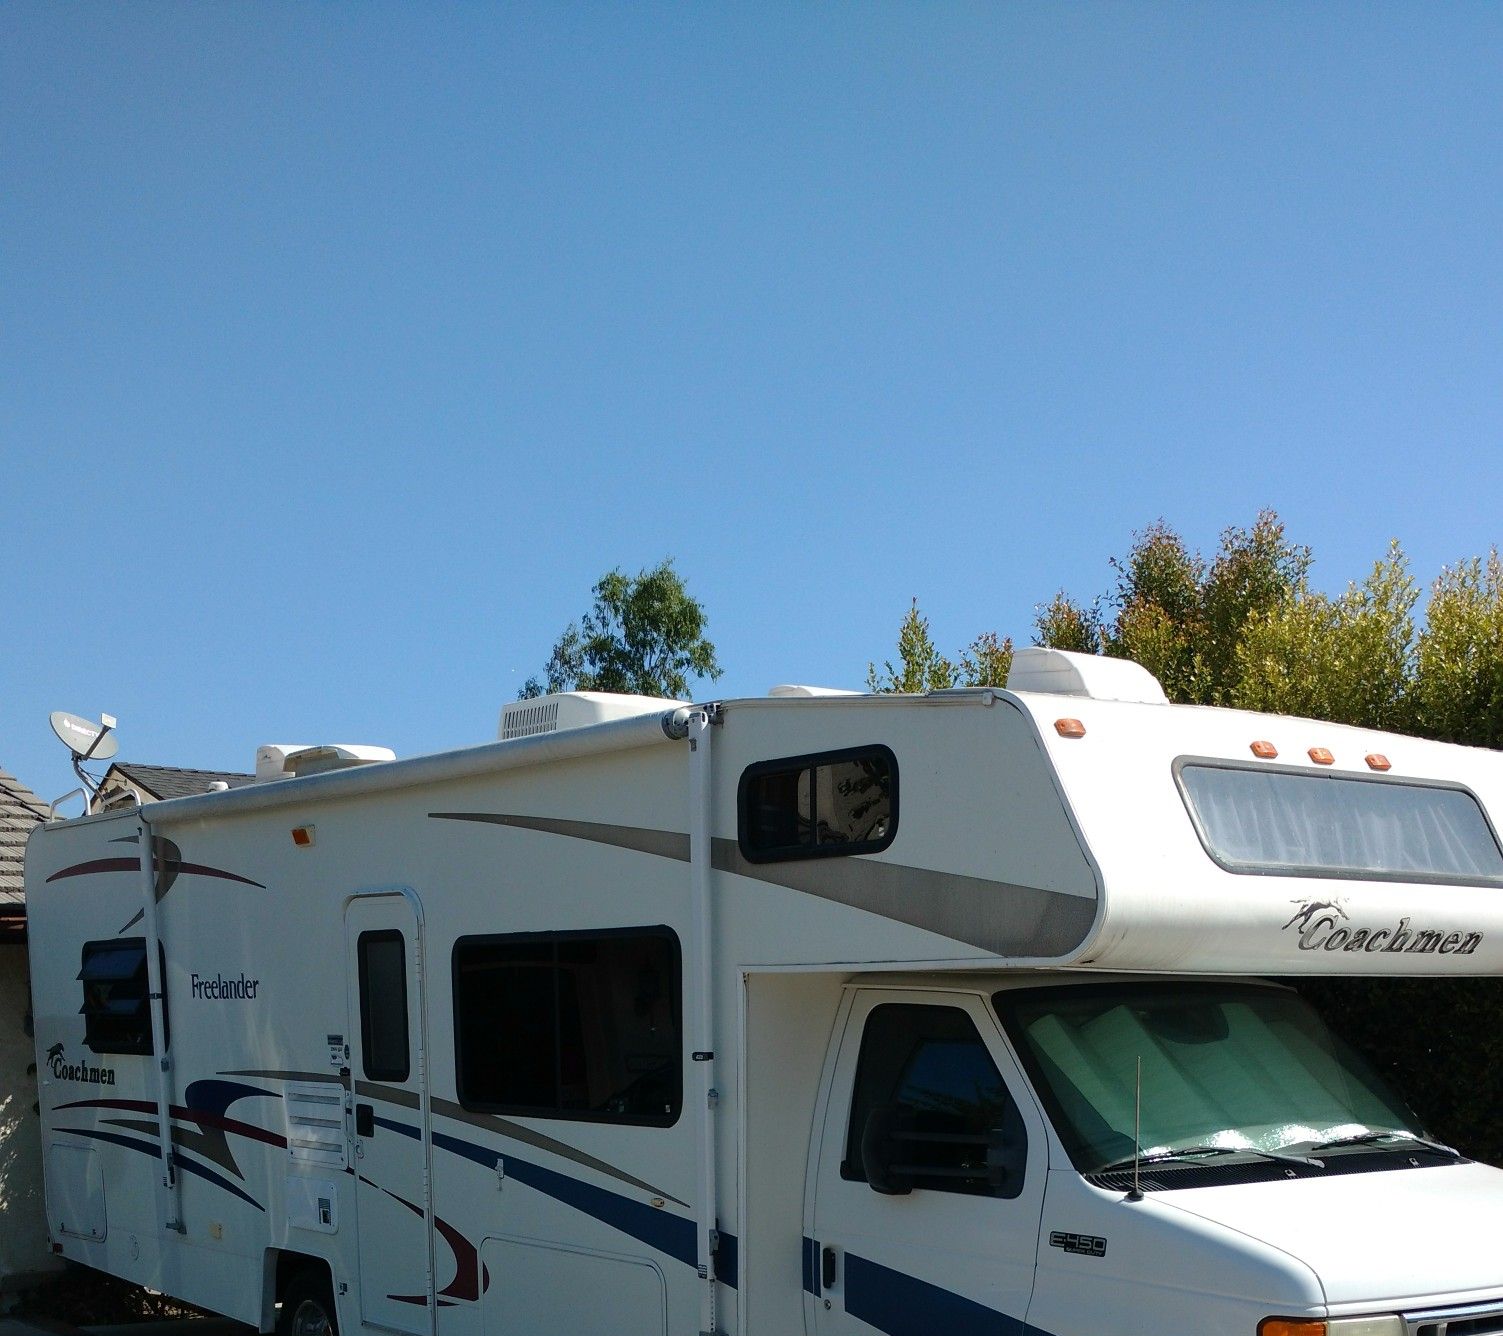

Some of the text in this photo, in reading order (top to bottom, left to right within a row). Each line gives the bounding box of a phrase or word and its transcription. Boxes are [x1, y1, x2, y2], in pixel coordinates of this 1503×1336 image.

[1298, 914, 1484, 955] Coachmen
[190, 972, 259, 999] Freelander
[53, 1057, 116, 1085] Coachmen
